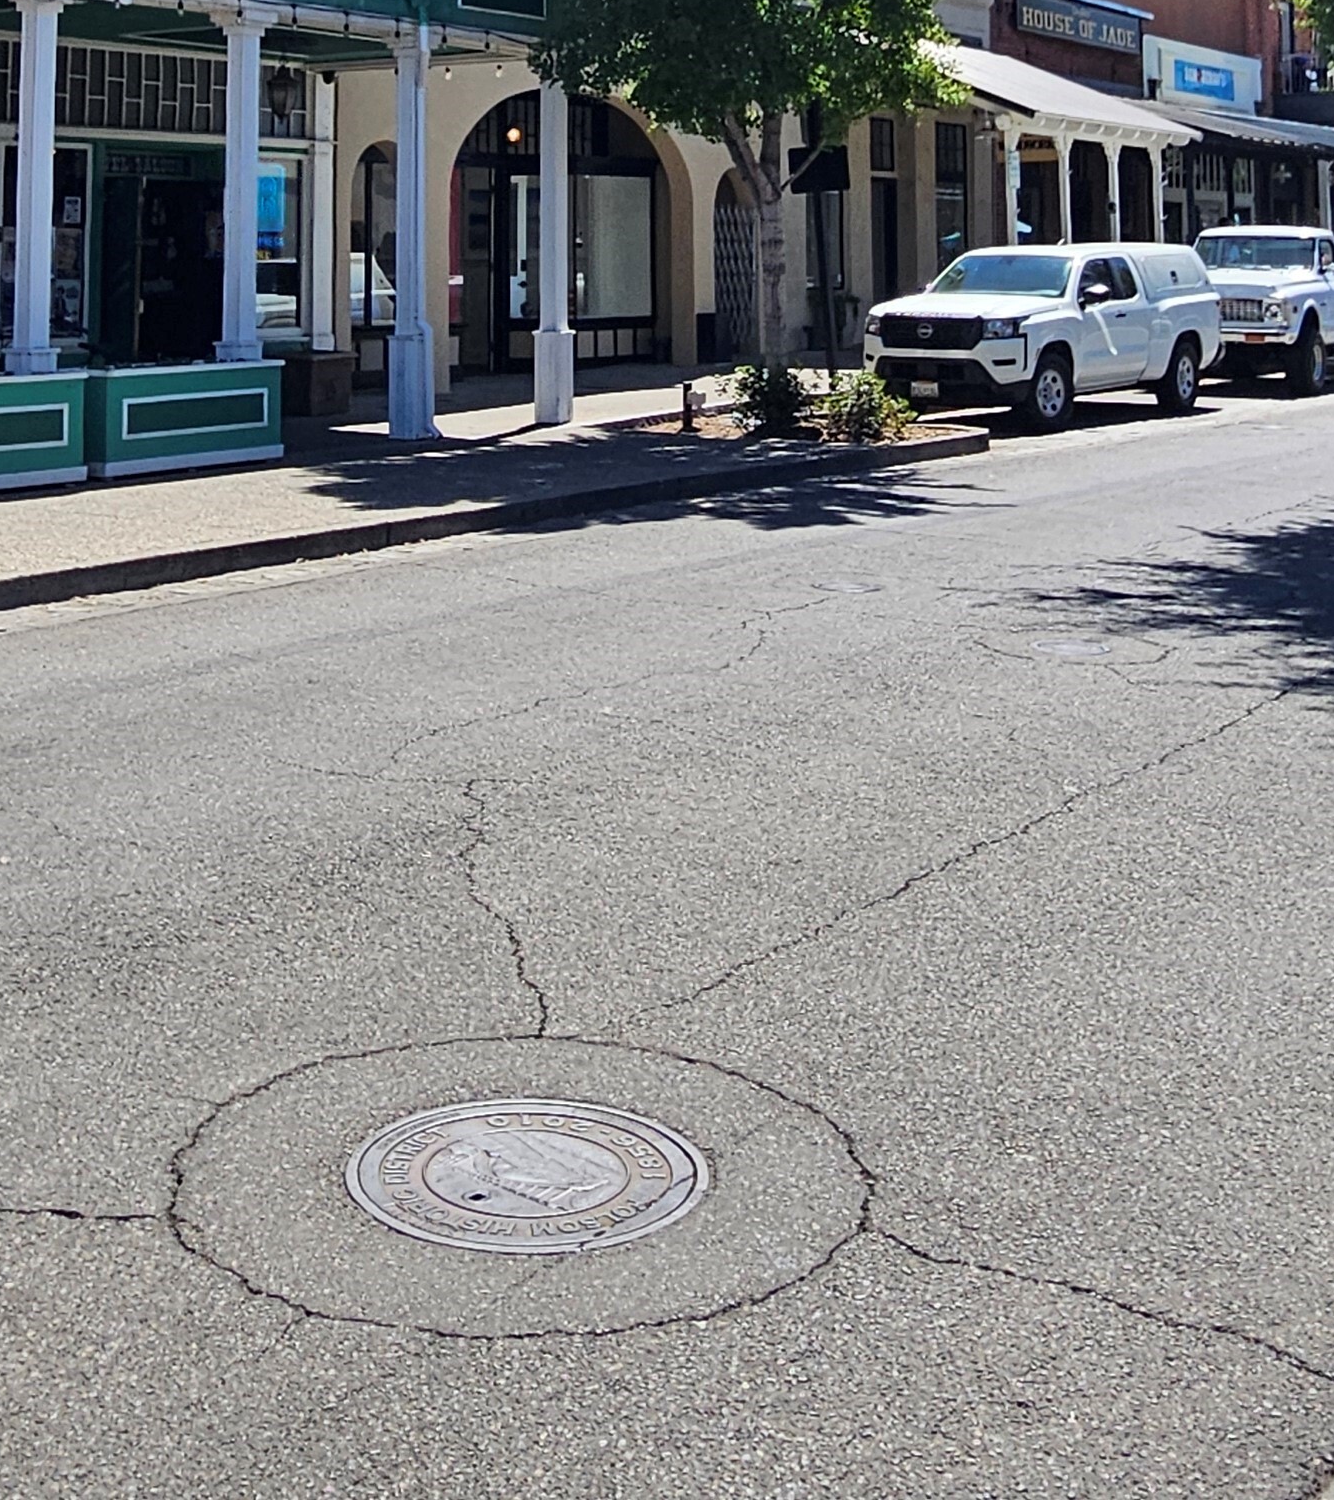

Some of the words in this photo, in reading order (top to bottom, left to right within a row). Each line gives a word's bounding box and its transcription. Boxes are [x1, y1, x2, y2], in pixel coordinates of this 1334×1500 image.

[1022, 5, 1075, 36] HOUSE
[1079, 19, 1097, 40] OF
[1098, 24, 1137, 49] JADE
[486, 1114, 595, 1132] 2010
[383, 1127, 448, 1186] DISTRICT
[610, 1136, 667, 1180] 1856
